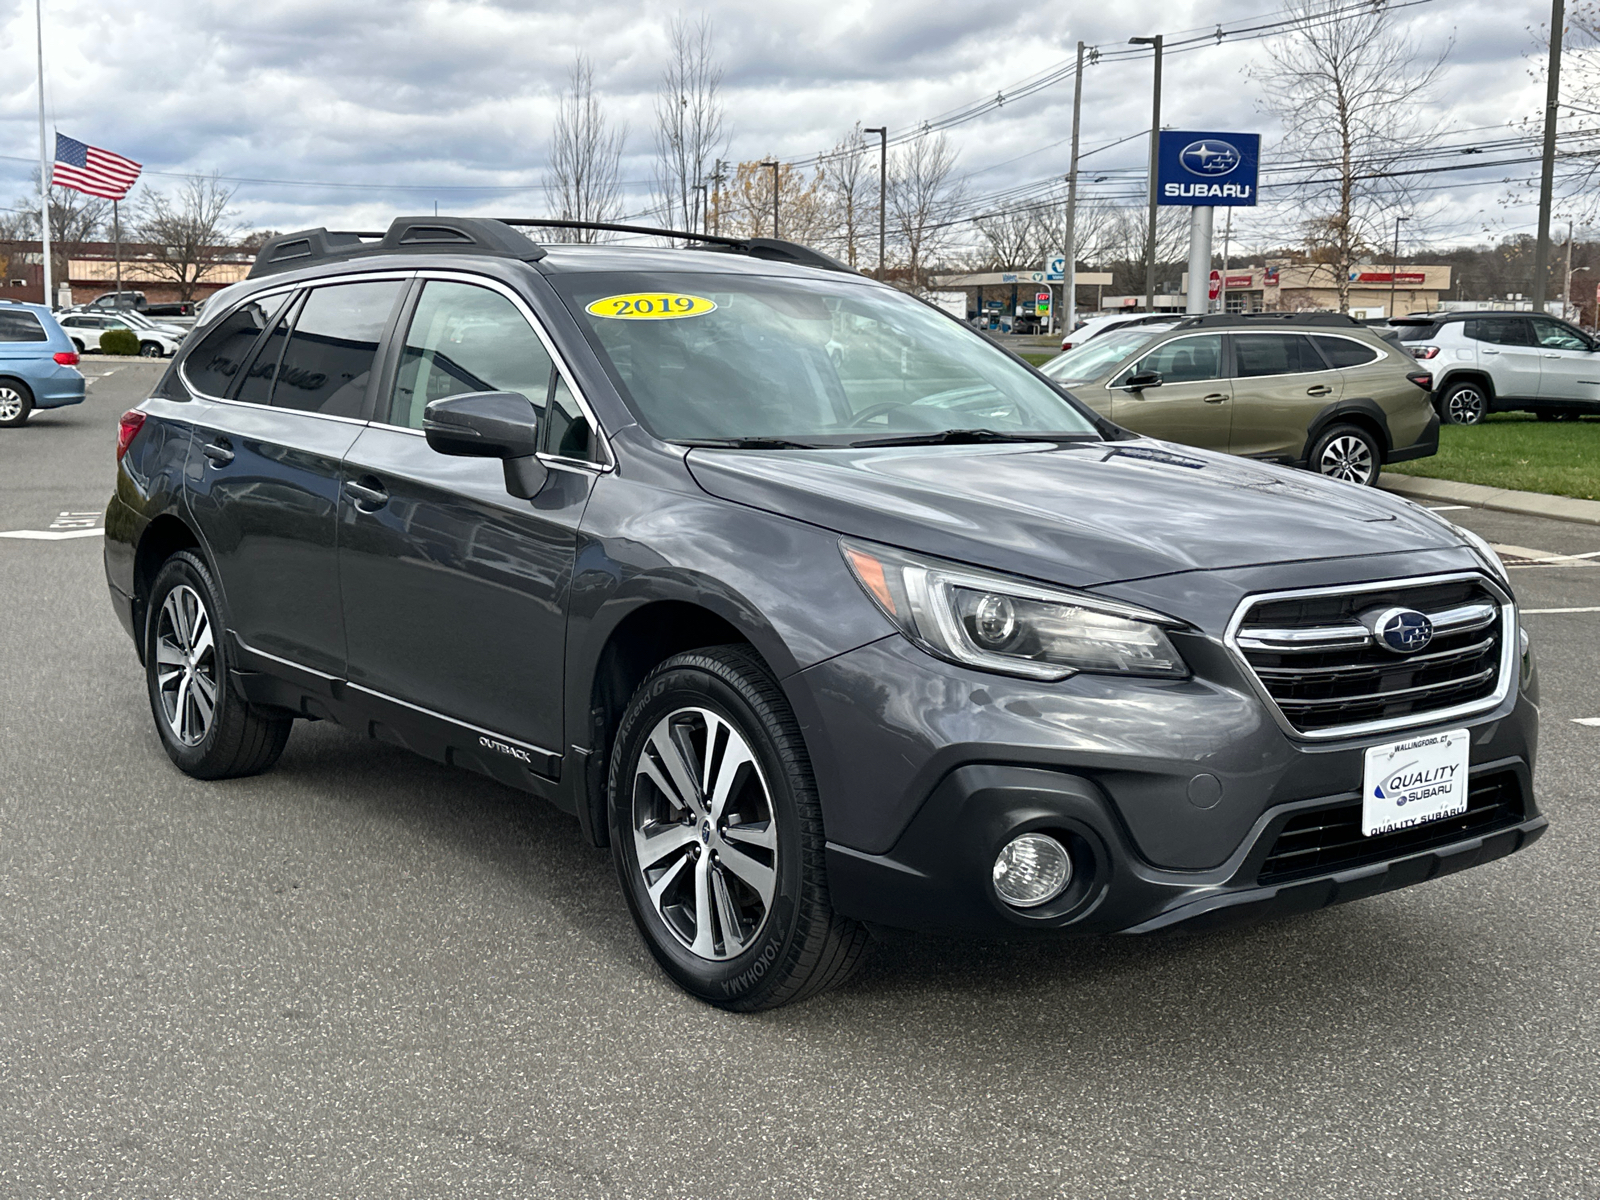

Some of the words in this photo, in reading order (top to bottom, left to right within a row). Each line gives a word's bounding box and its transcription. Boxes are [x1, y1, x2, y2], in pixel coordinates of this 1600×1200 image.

[1164, 183, 1250, 198] SUBARU
[612, 297, 695, 316] 2019
[621, 691, 651, 744] Ascend
[652, 673, 679, 697] GT
[478, 736, 532, 764] OUTBACK
[1389, 763, 1460, 790] QUALITY
[1408, 783, 1453, 802] SUBARU
[1370, 817, 1418, 836] QUALITY
[1419, 806, 1465, 823] SUBARU
[720, 937, 781, 996] YOKOHAMA
